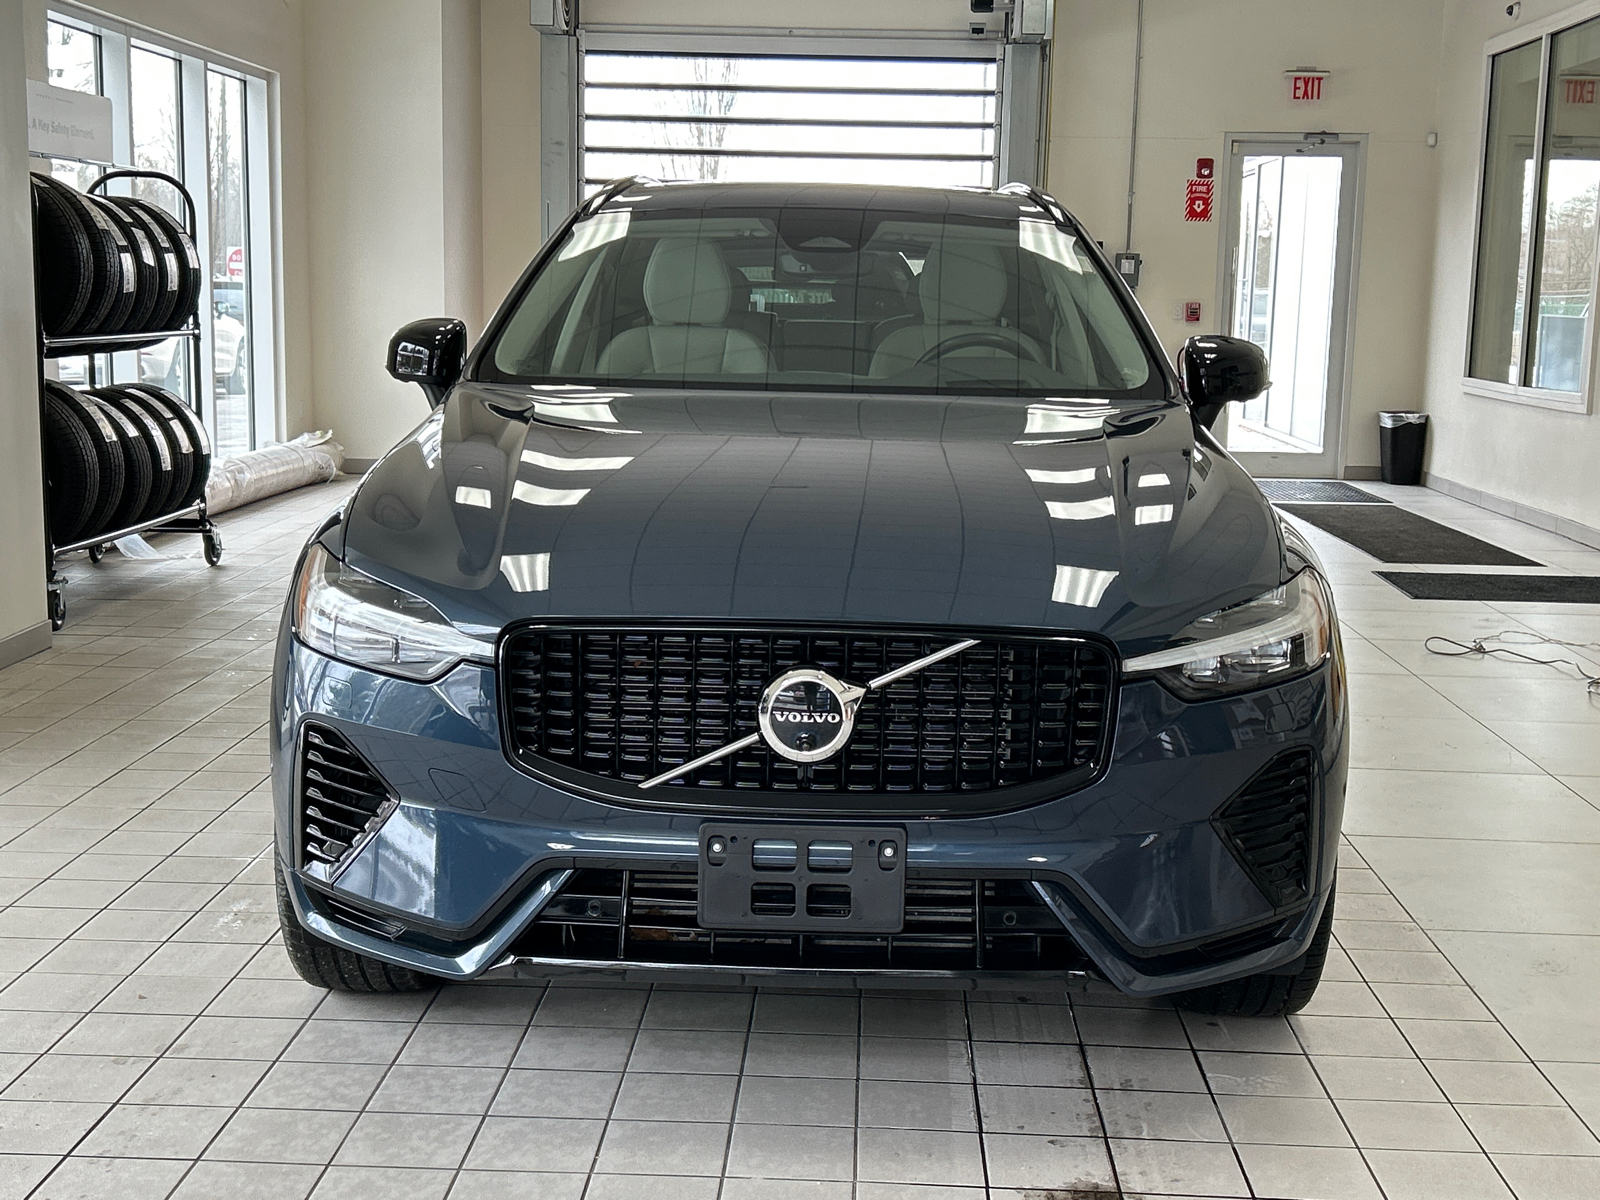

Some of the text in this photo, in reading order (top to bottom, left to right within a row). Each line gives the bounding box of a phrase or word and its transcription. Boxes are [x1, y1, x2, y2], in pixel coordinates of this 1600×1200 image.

[1293, 76, 1324, 100] EXIT
[38, 119, 50, 135] Key
[51, 121, 70, 138] Safety
[1192, 185, 1209, 193] FIRE
[772, 710, 841, 724] VOLVO
